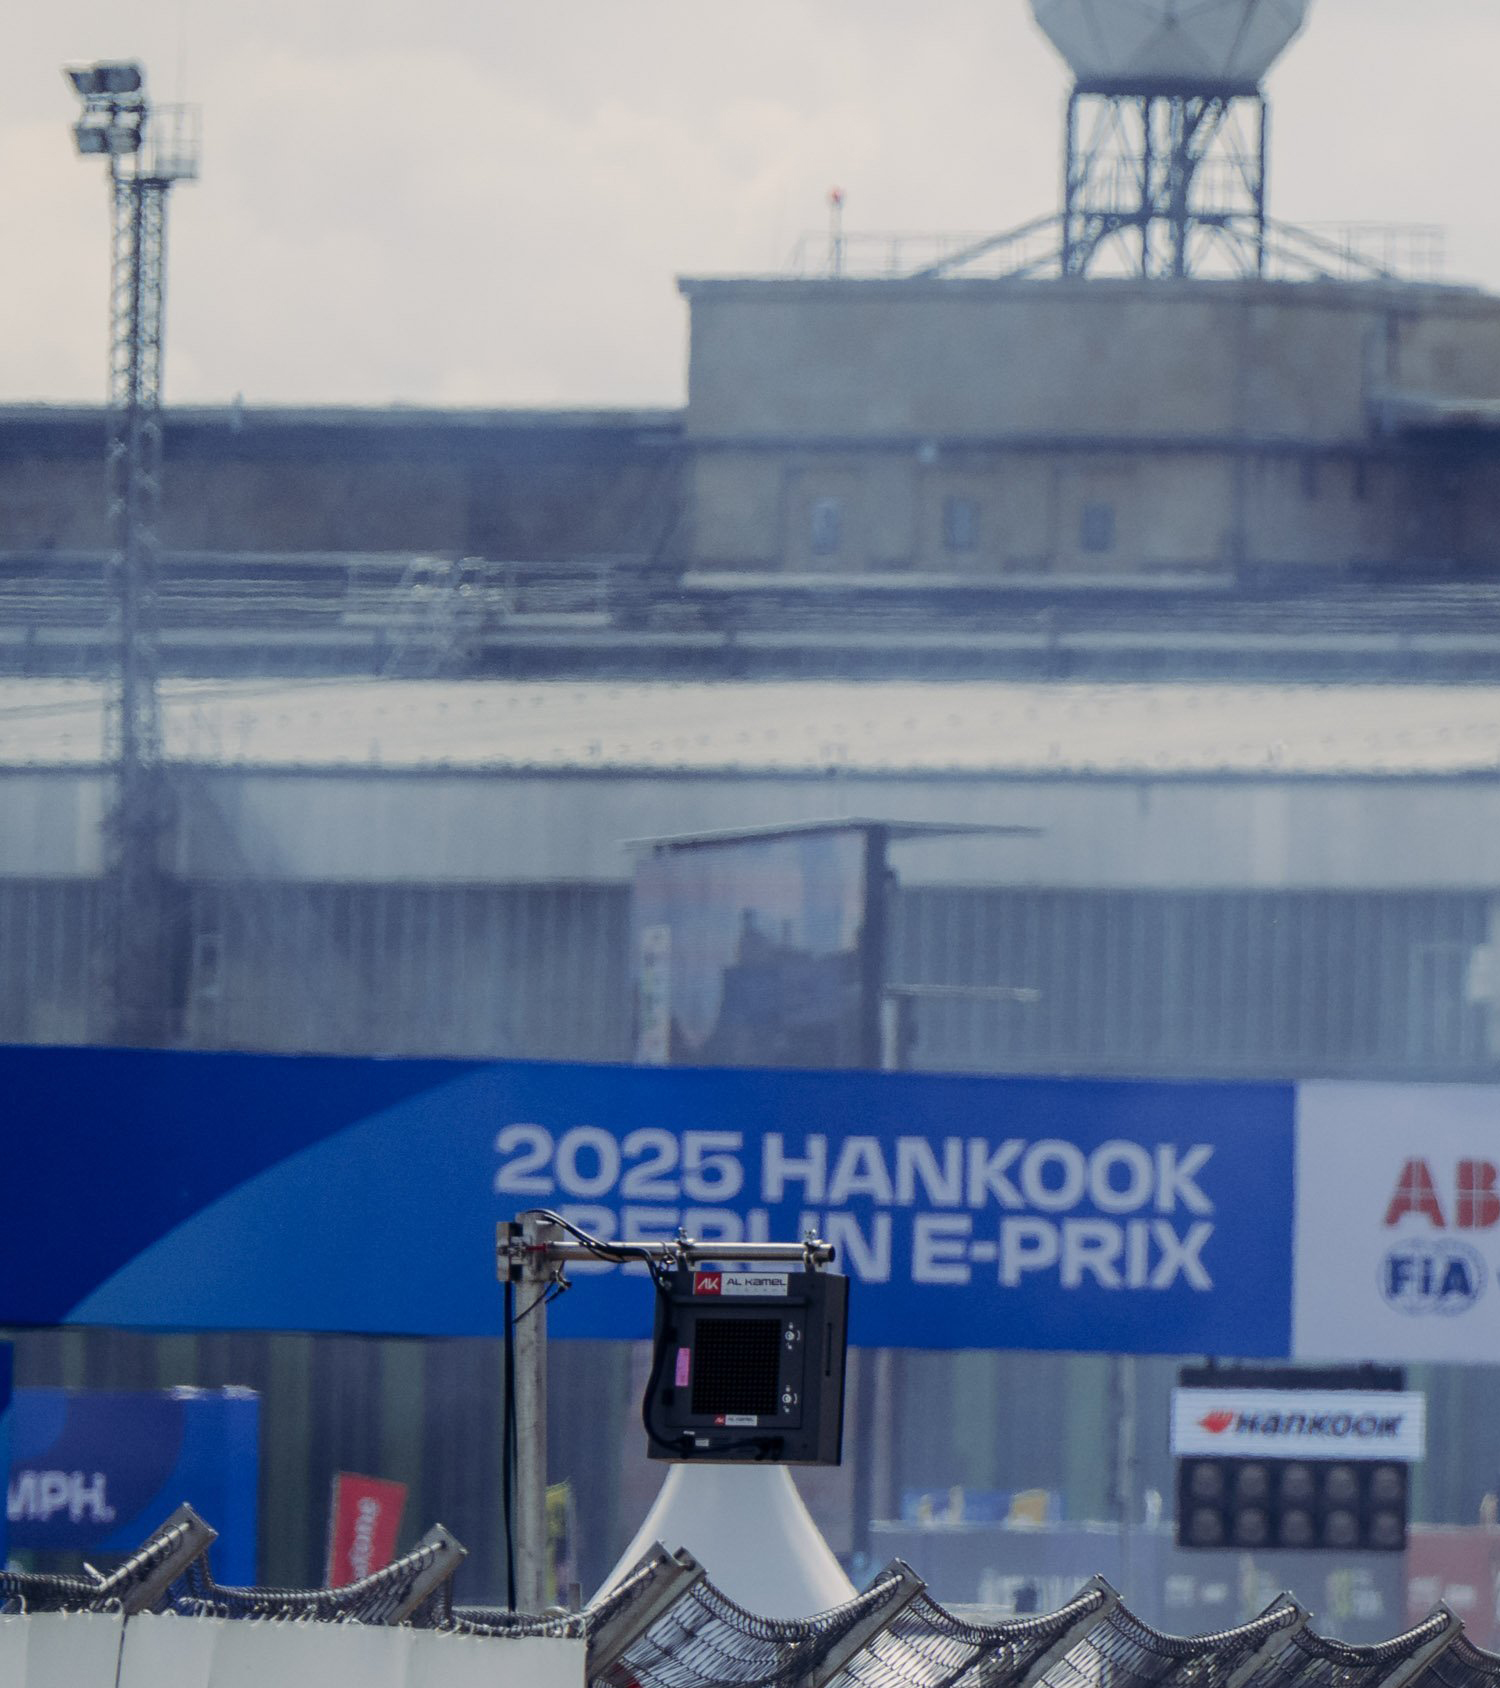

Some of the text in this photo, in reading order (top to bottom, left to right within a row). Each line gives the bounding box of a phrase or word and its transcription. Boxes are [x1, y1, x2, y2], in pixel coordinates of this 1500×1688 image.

[494, 1123, 1214, 1215] 2025 HANKOOK
[910, 1214, 1214, 1292] E-PRIX
